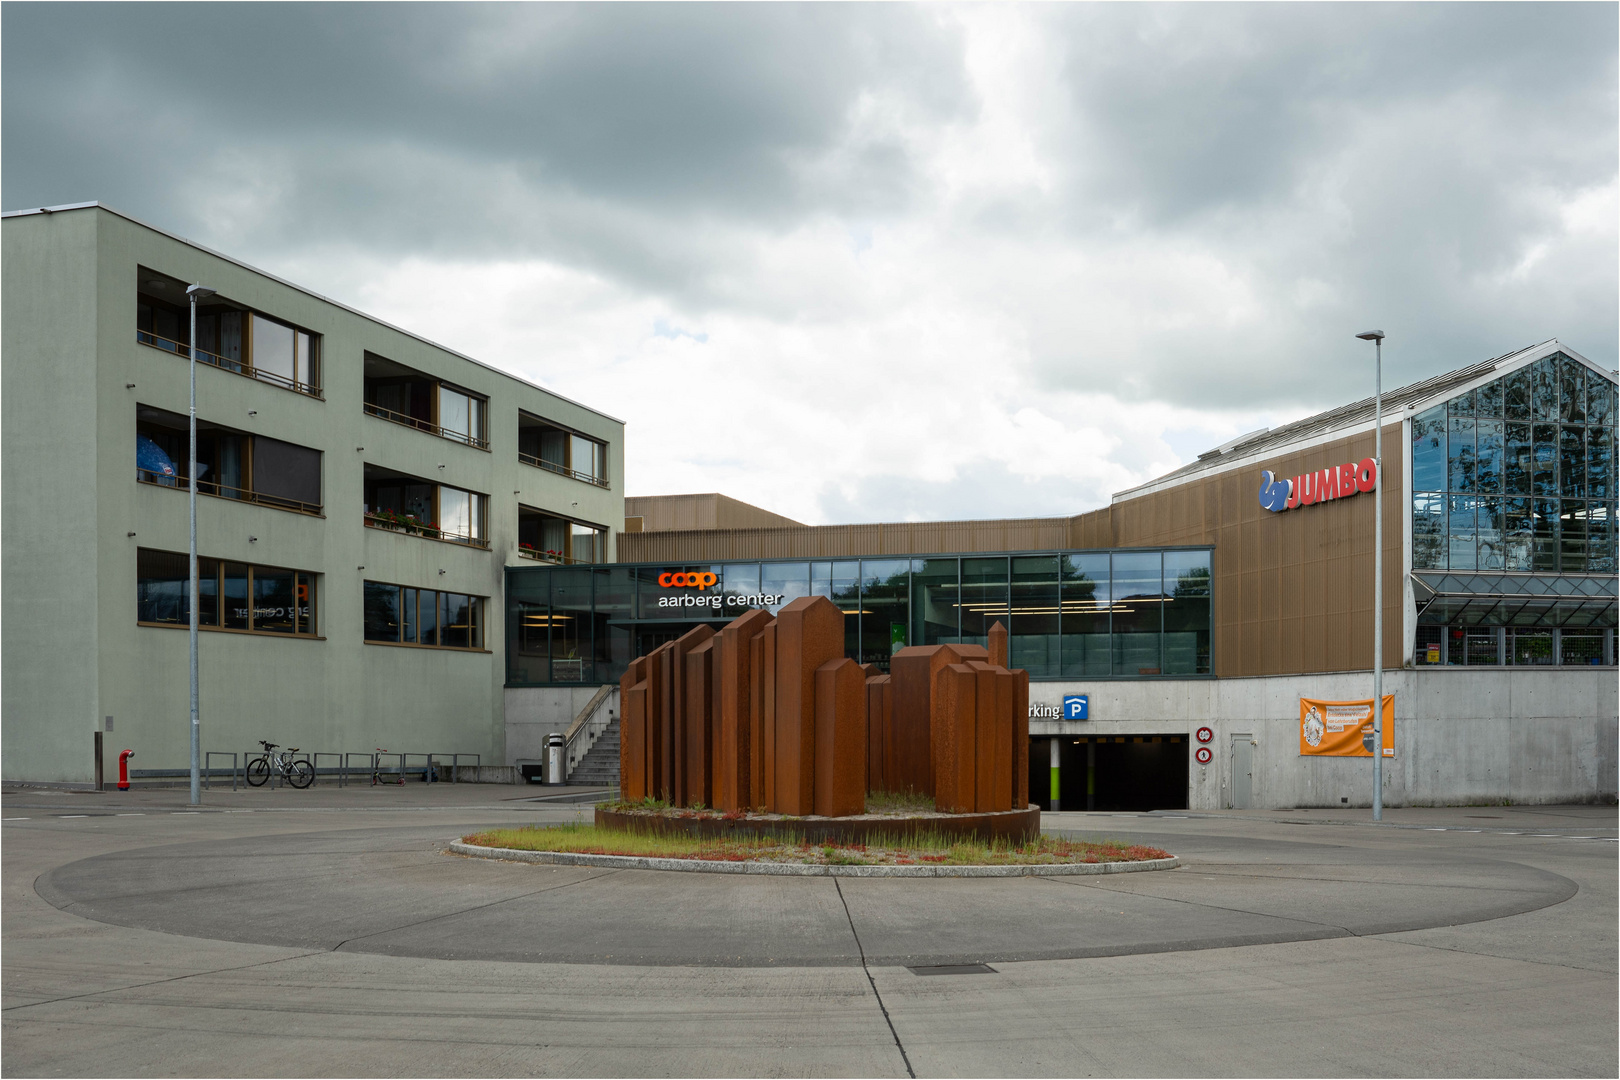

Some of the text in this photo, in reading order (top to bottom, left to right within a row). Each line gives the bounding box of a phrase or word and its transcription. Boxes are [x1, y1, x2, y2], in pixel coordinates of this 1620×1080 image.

[1288, 457, 1377, 509] JUMBO
[658, 571, 717, 591] coop
[658, 592, 782, 609] aarberg center
[1029, 704, 1081, 720] rking P
